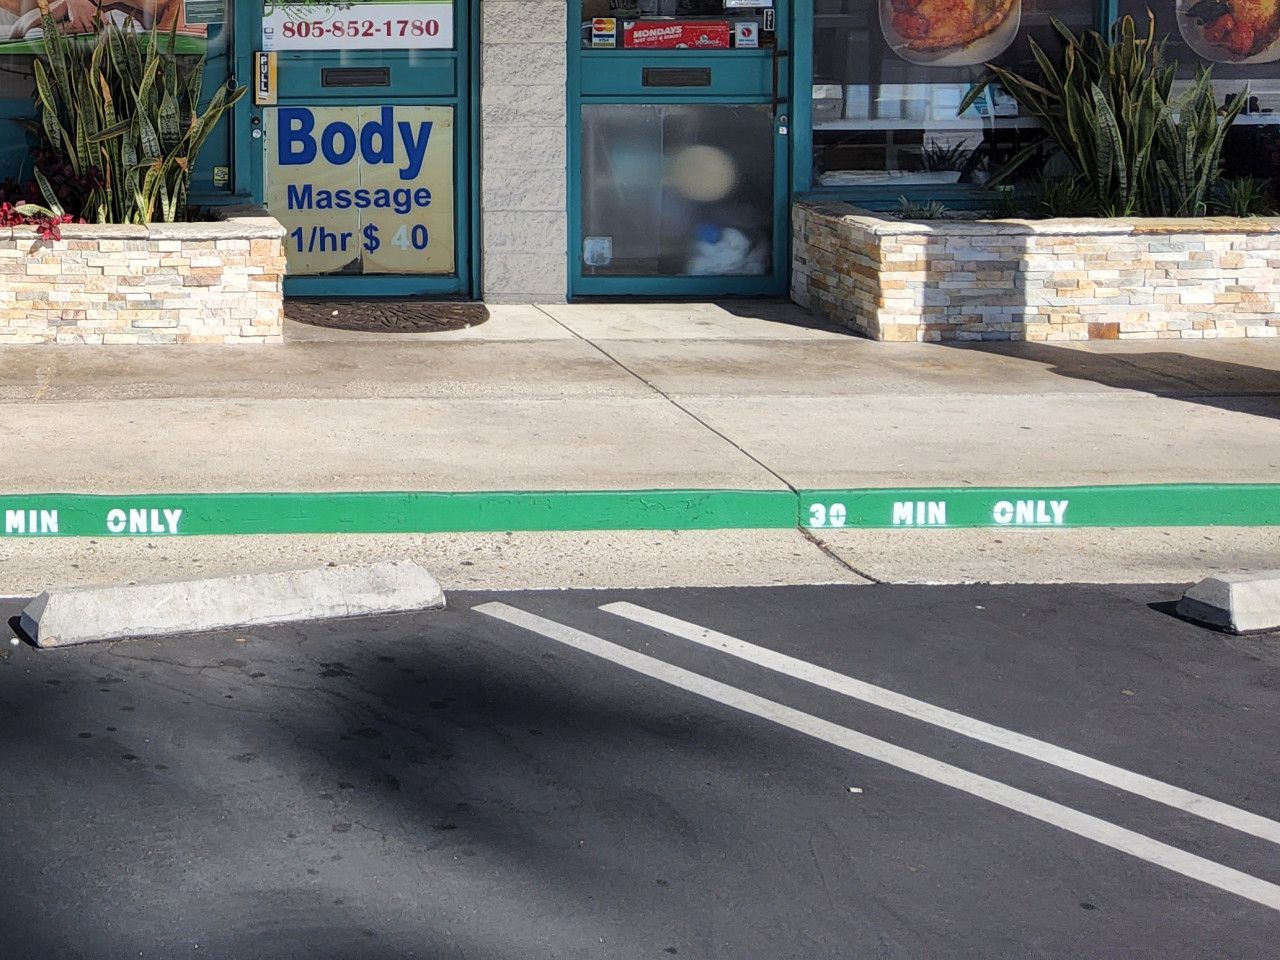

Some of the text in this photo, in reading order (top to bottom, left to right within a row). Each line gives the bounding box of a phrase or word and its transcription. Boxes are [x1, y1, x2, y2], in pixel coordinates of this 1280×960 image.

[282, 19, 440, 38] 805-852-1780
[632, 26, 683, 39] MONDAYS
[260, 56, 269, 91] PULL
[277, 106, 433, 180] Body
[287, 184, 432, 215] Massage
[291, 225, 352, 252] 1/hr
[362, 223, 381, 254] $
[5, 509, 59, 533] MIN
[107, 508, 182, 534] ONLY
[809, 500, 1069, 527] 30 MIN ONLY
